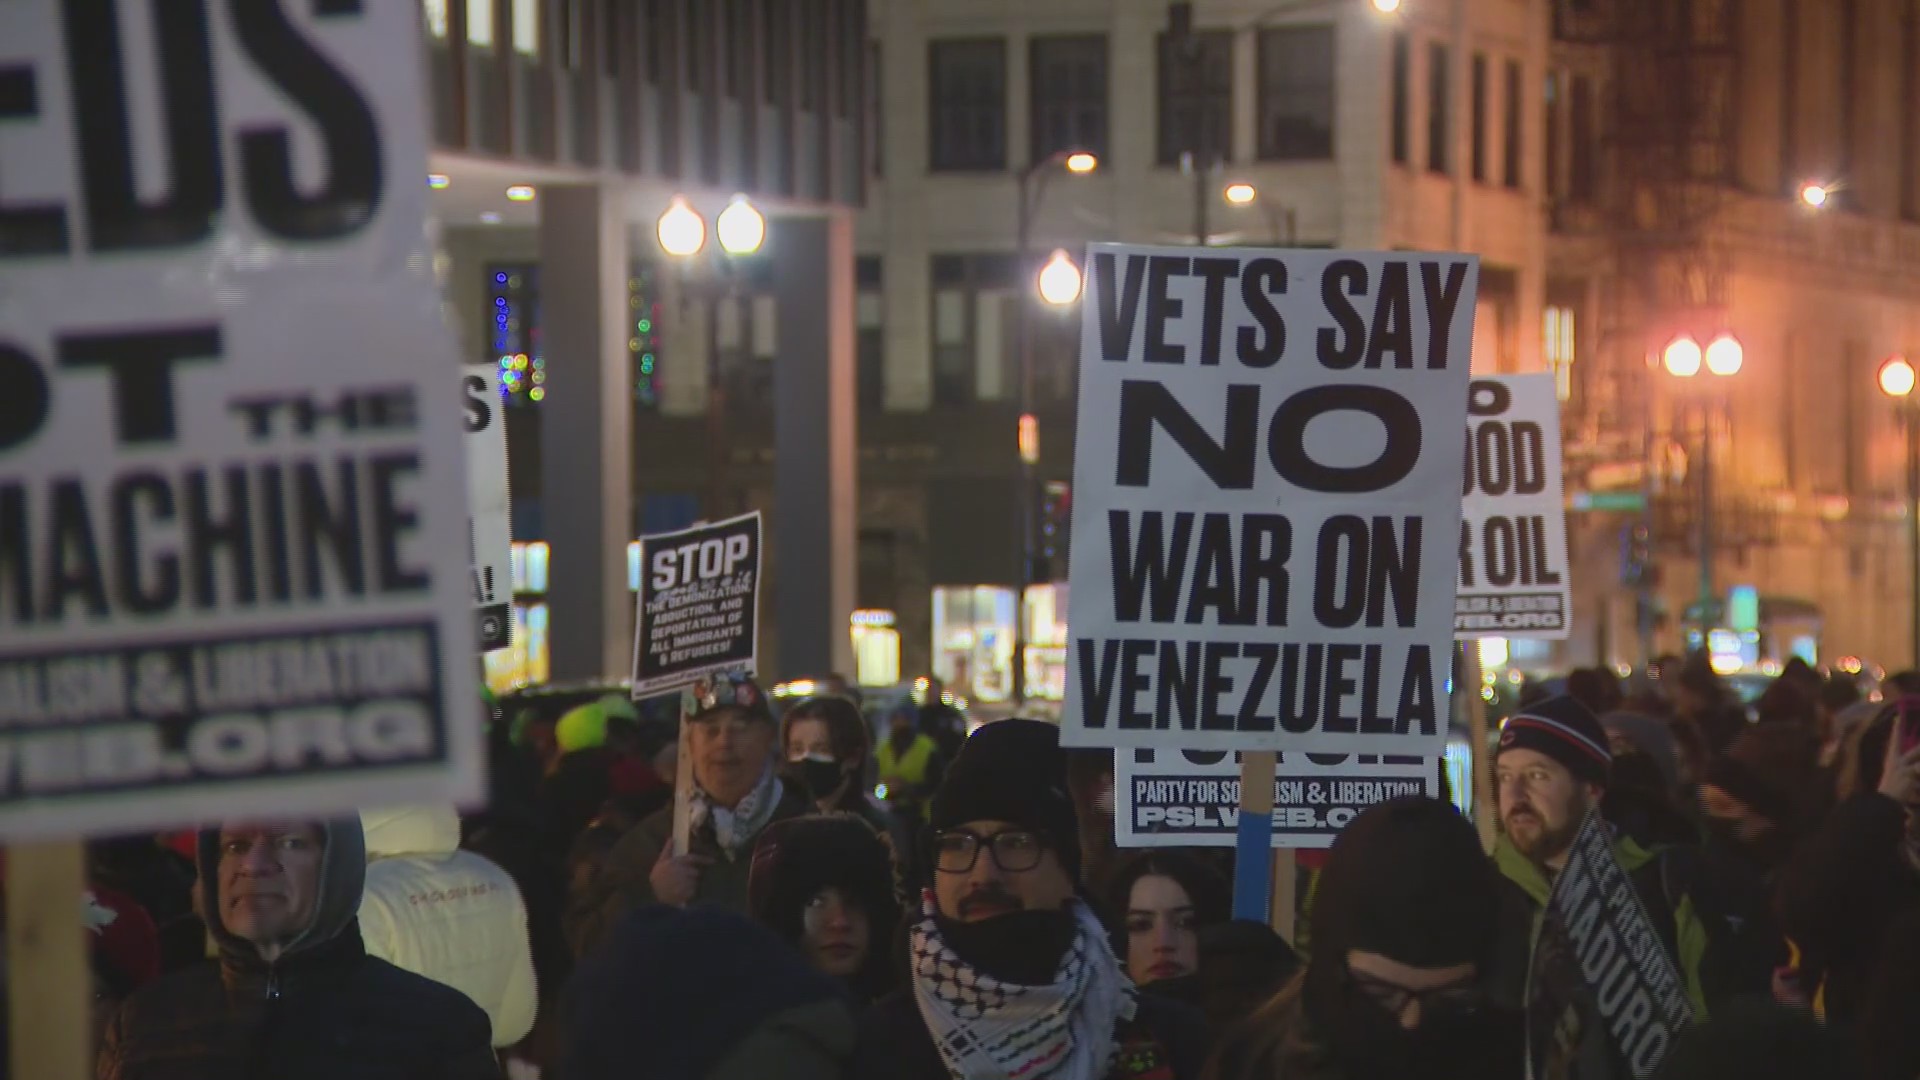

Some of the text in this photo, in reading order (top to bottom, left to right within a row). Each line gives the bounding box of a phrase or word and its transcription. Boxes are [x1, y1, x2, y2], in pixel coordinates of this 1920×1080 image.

[1094, 253, 1469, 370] VETS SAY
[226, 383, 420, 438] THE
[1114, 379, 1422, 493] NO
[652, 533, 749, 591] STOP
[1108, 510, 1293, 627] WAR
[1313, 514, 1422, 628] ON
[1483, 515, 1560, 588] OIL
[646, 601, 665, 615] THE
[651, 611, 743, 640] DEPORTATION OF
[719, 597, 743, 611] AND
[649, 625, 743, 655] ALL IMMIGRANTS
[1076, 639, 1437, 736] VENEZUELA
[1136, 780, 1186, 803] PARTY
[1188, 780, 1218, 803] FOR
[1306, 781, 1327, 804] &
[1556, 852, 1669, 1079] MADURO
[1608, 883, 1694, 1032] PRESIDENT
